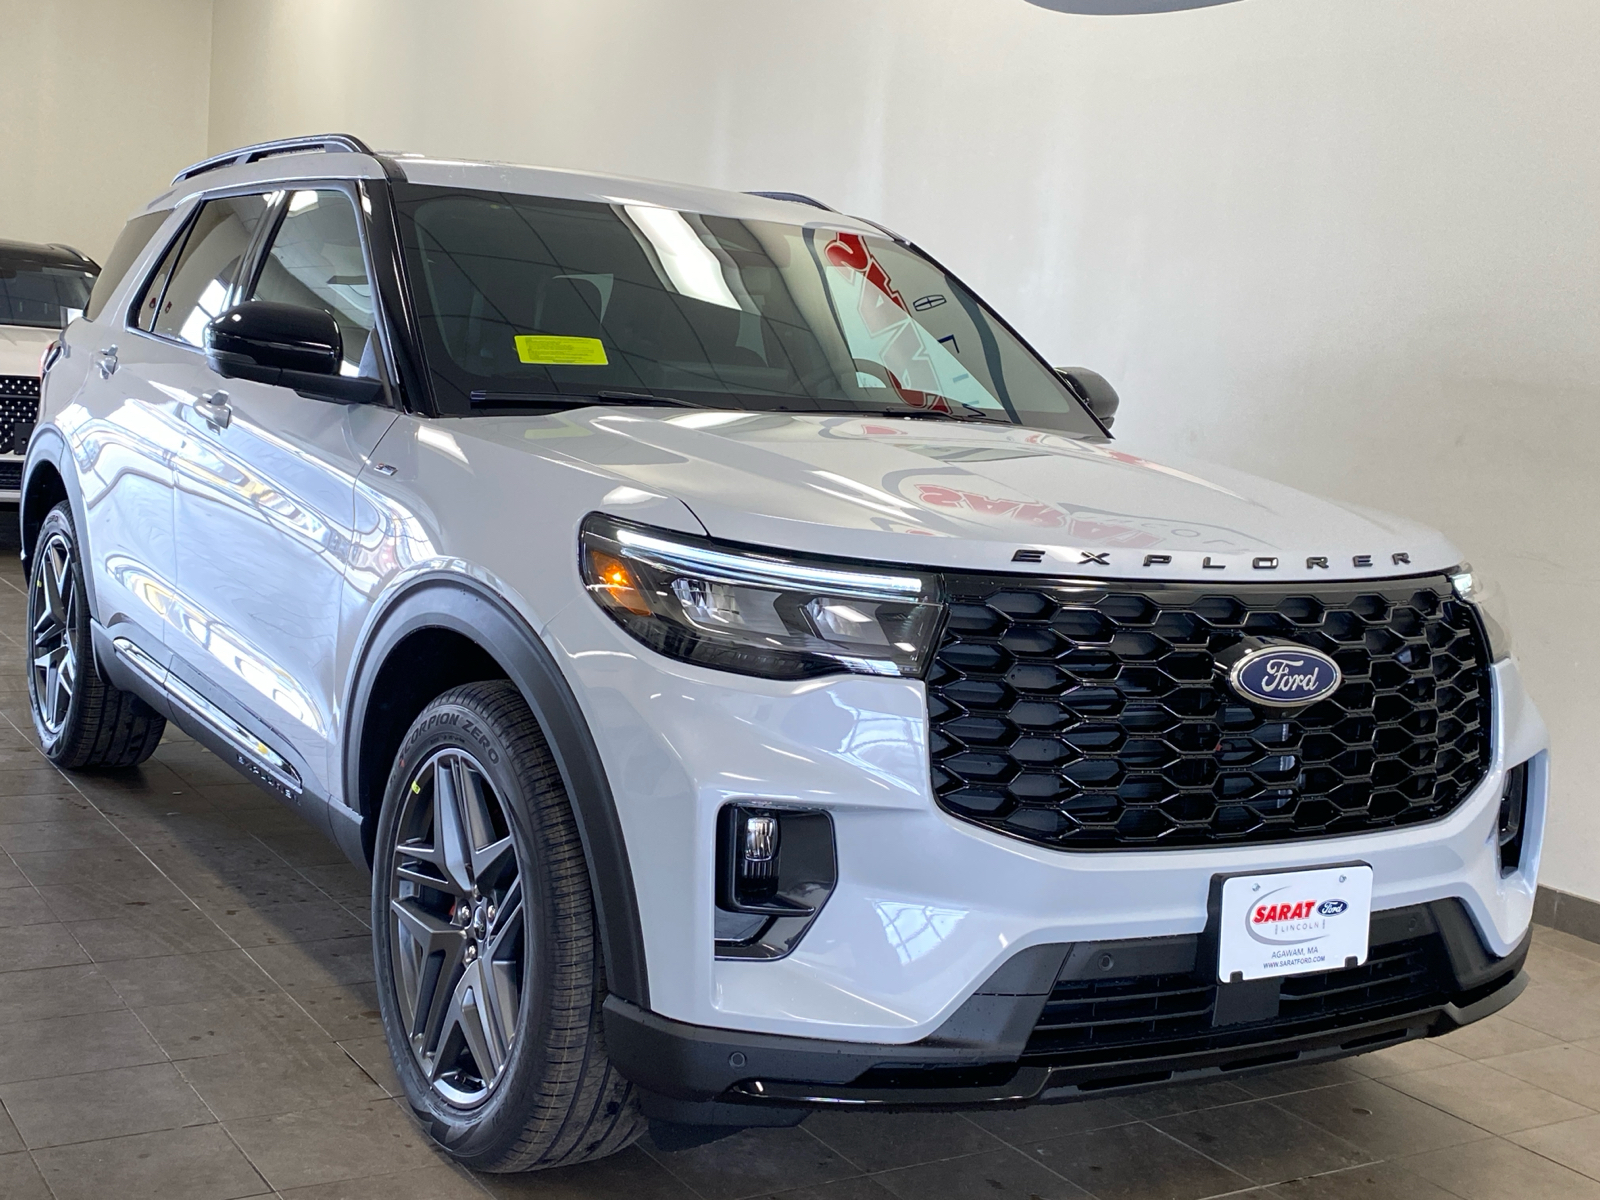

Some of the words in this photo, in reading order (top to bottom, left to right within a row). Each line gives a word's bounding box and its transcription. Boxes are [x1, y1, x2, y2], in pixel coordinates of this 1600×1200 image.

[1011, 549, 1411, 570] EXPLORER
[1261, 658, 1319, 692] Ford
[462, 719, 500, 765] ZERO
[1253, 901, 1316, 923] SARAT
[1321, 901, 1343, 914] Ford
[1281, 922, 1320, 932] LINCOLN
[1263, 956, 1326, 969] WWW.SARATFORD.COM
[1271, 948, 1305, 959] AGAWAM,
[1307, 946, 1319, 954] MA
